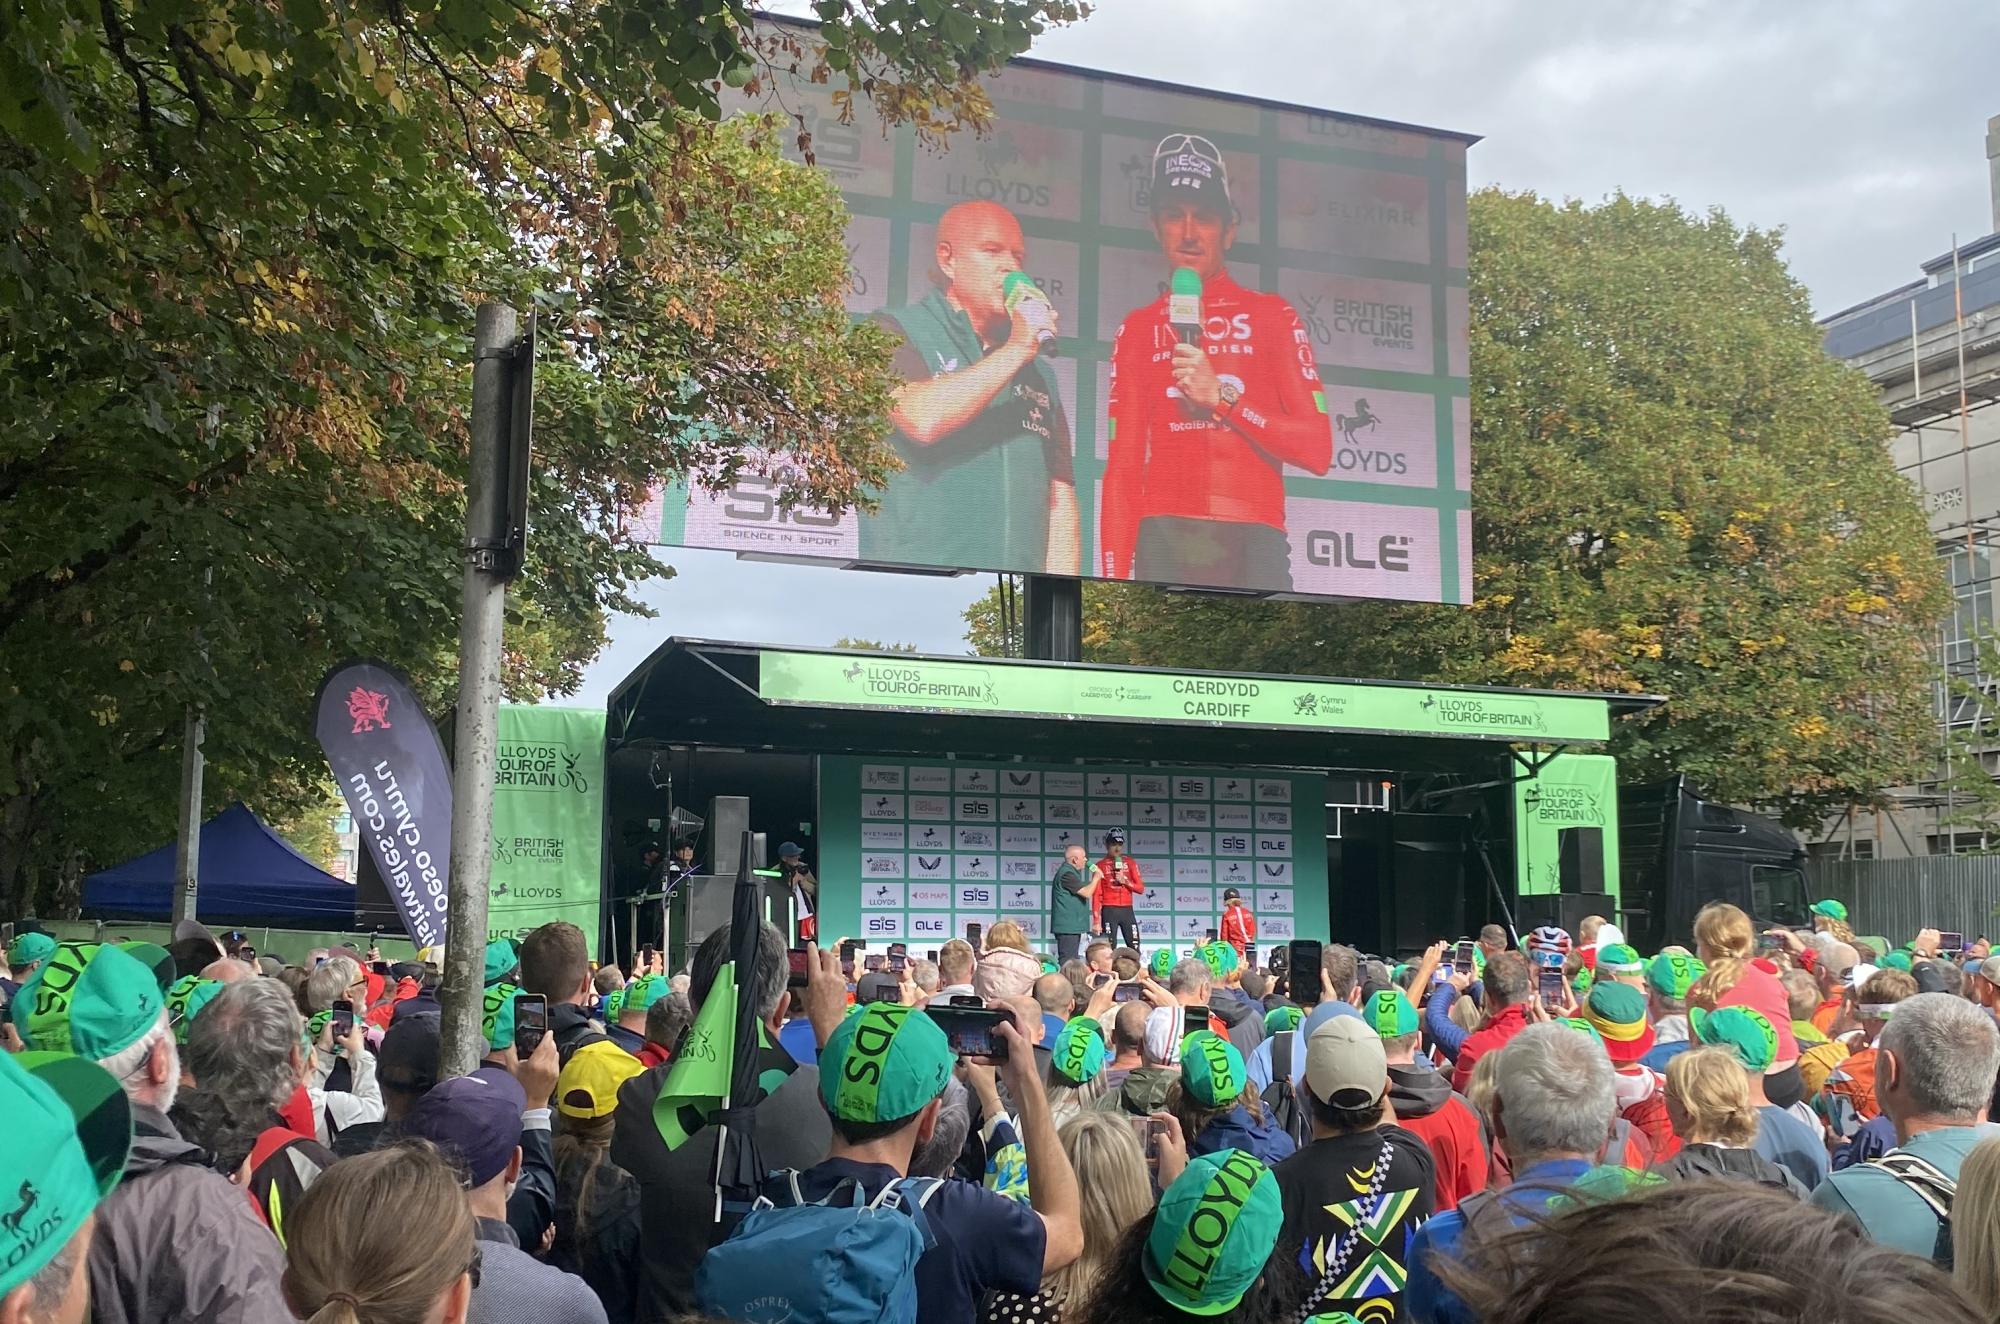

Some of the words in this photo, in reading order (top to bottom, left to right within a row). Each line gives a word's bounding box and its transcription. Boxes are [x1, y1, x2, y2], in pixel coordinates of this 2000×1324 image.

[1165, 154, 1213, 174] INEOS
[945, 172, 1051, 207] LLOYDS
[1333, 298, 1413, 322] BRITISH
[1153, 313, 1252, 350] INOS
[1334, 317, 1413, 340] CYCLING
[1152, 344, 1254, 363] GRDIER
[723, 529, 775, 542] SCIENCE
[780, 534, 793, 544] IN
[799, 535, 840, 547] SPORT
[868, 667, 921, 682] LLOYDS
[928, 684, 981, 698] BRITAIN
[1172, 680, 1260, 698] CAERDYDD
[1319, 695, 1347, 706] Cymru
[1439, 699, 1483, 712] LLOYDS
[1183, 701, 1252, 718] CARDIFF
[1320, 705, 1344, 715] Wales
[1489, 713, 1533, 726] BRITAIN
[501, 746, 556, 760] LLOYDS
[534, 760, 557, 772] OF
[1545, 788, 1584, 798] LLOYDS
[962, 800, 989, 815] SiS
[1570, 799, 1584, 809] OF
[1539, 808, 1585, 821] BRITAIN
[513, 837, 565, 848] BRITISH
[1222, 836, 1246, 850] SiS
[513, 848, 565, 858] CYCLING
[513, 887, 563, 899] LLOYDS
[963, 888, 989, 902] SiS
[869, 916, 897, 931] SiS
[36, 945, 88, 1017] YDS
[845, 1008, 910, 1087] YDS
[1066, 1026, 1092, 1072] OYDS
